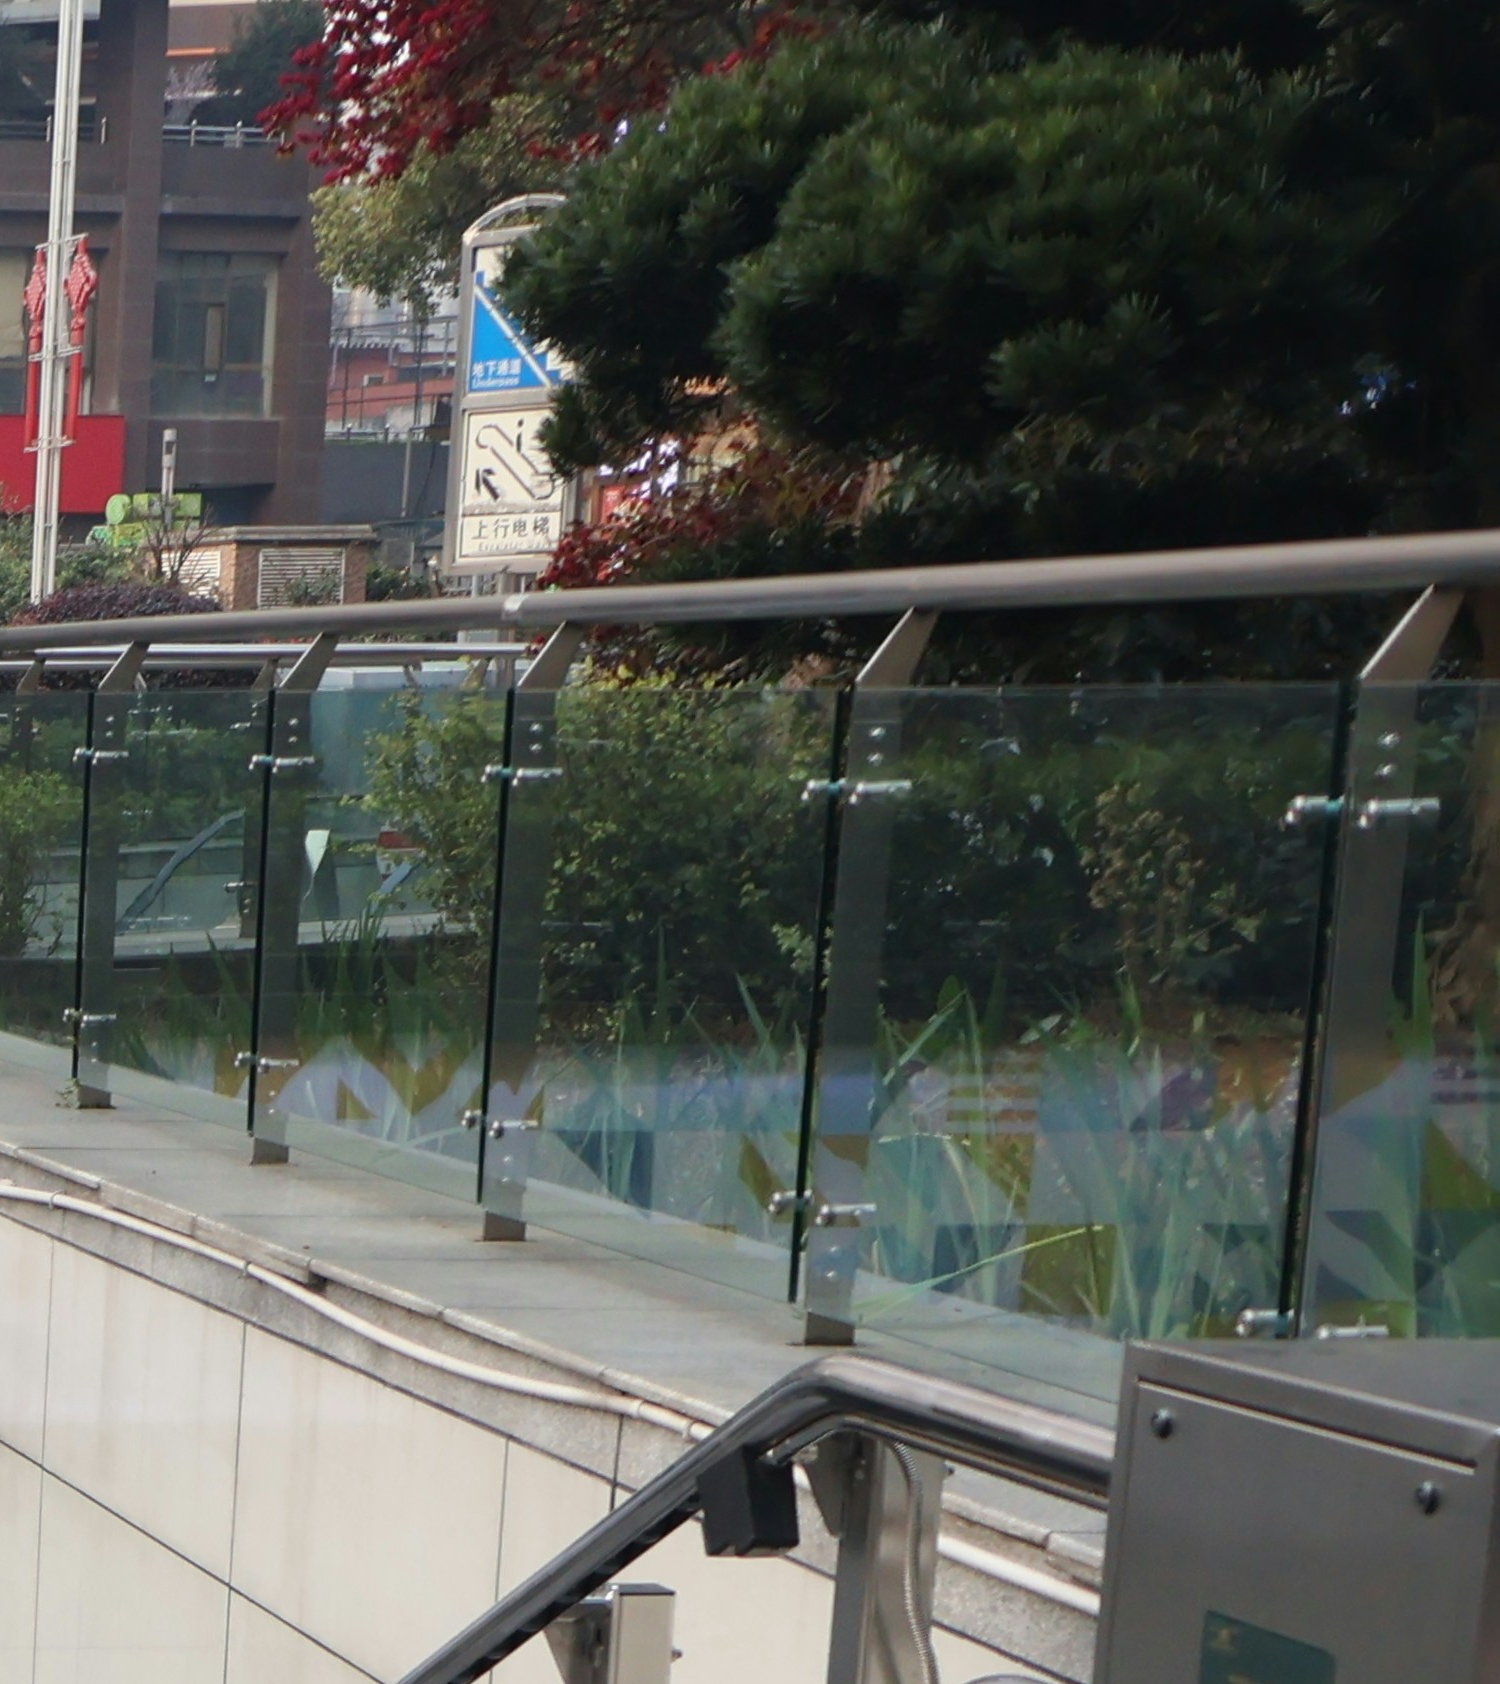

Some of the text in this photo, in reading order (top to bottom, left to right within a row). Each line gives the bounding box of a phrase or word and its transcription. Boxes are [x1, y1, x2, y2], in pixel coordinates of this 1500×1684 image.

[472, 358, 521, 378] 地下通道
[472, 517, 550, 540] 上行电梯
